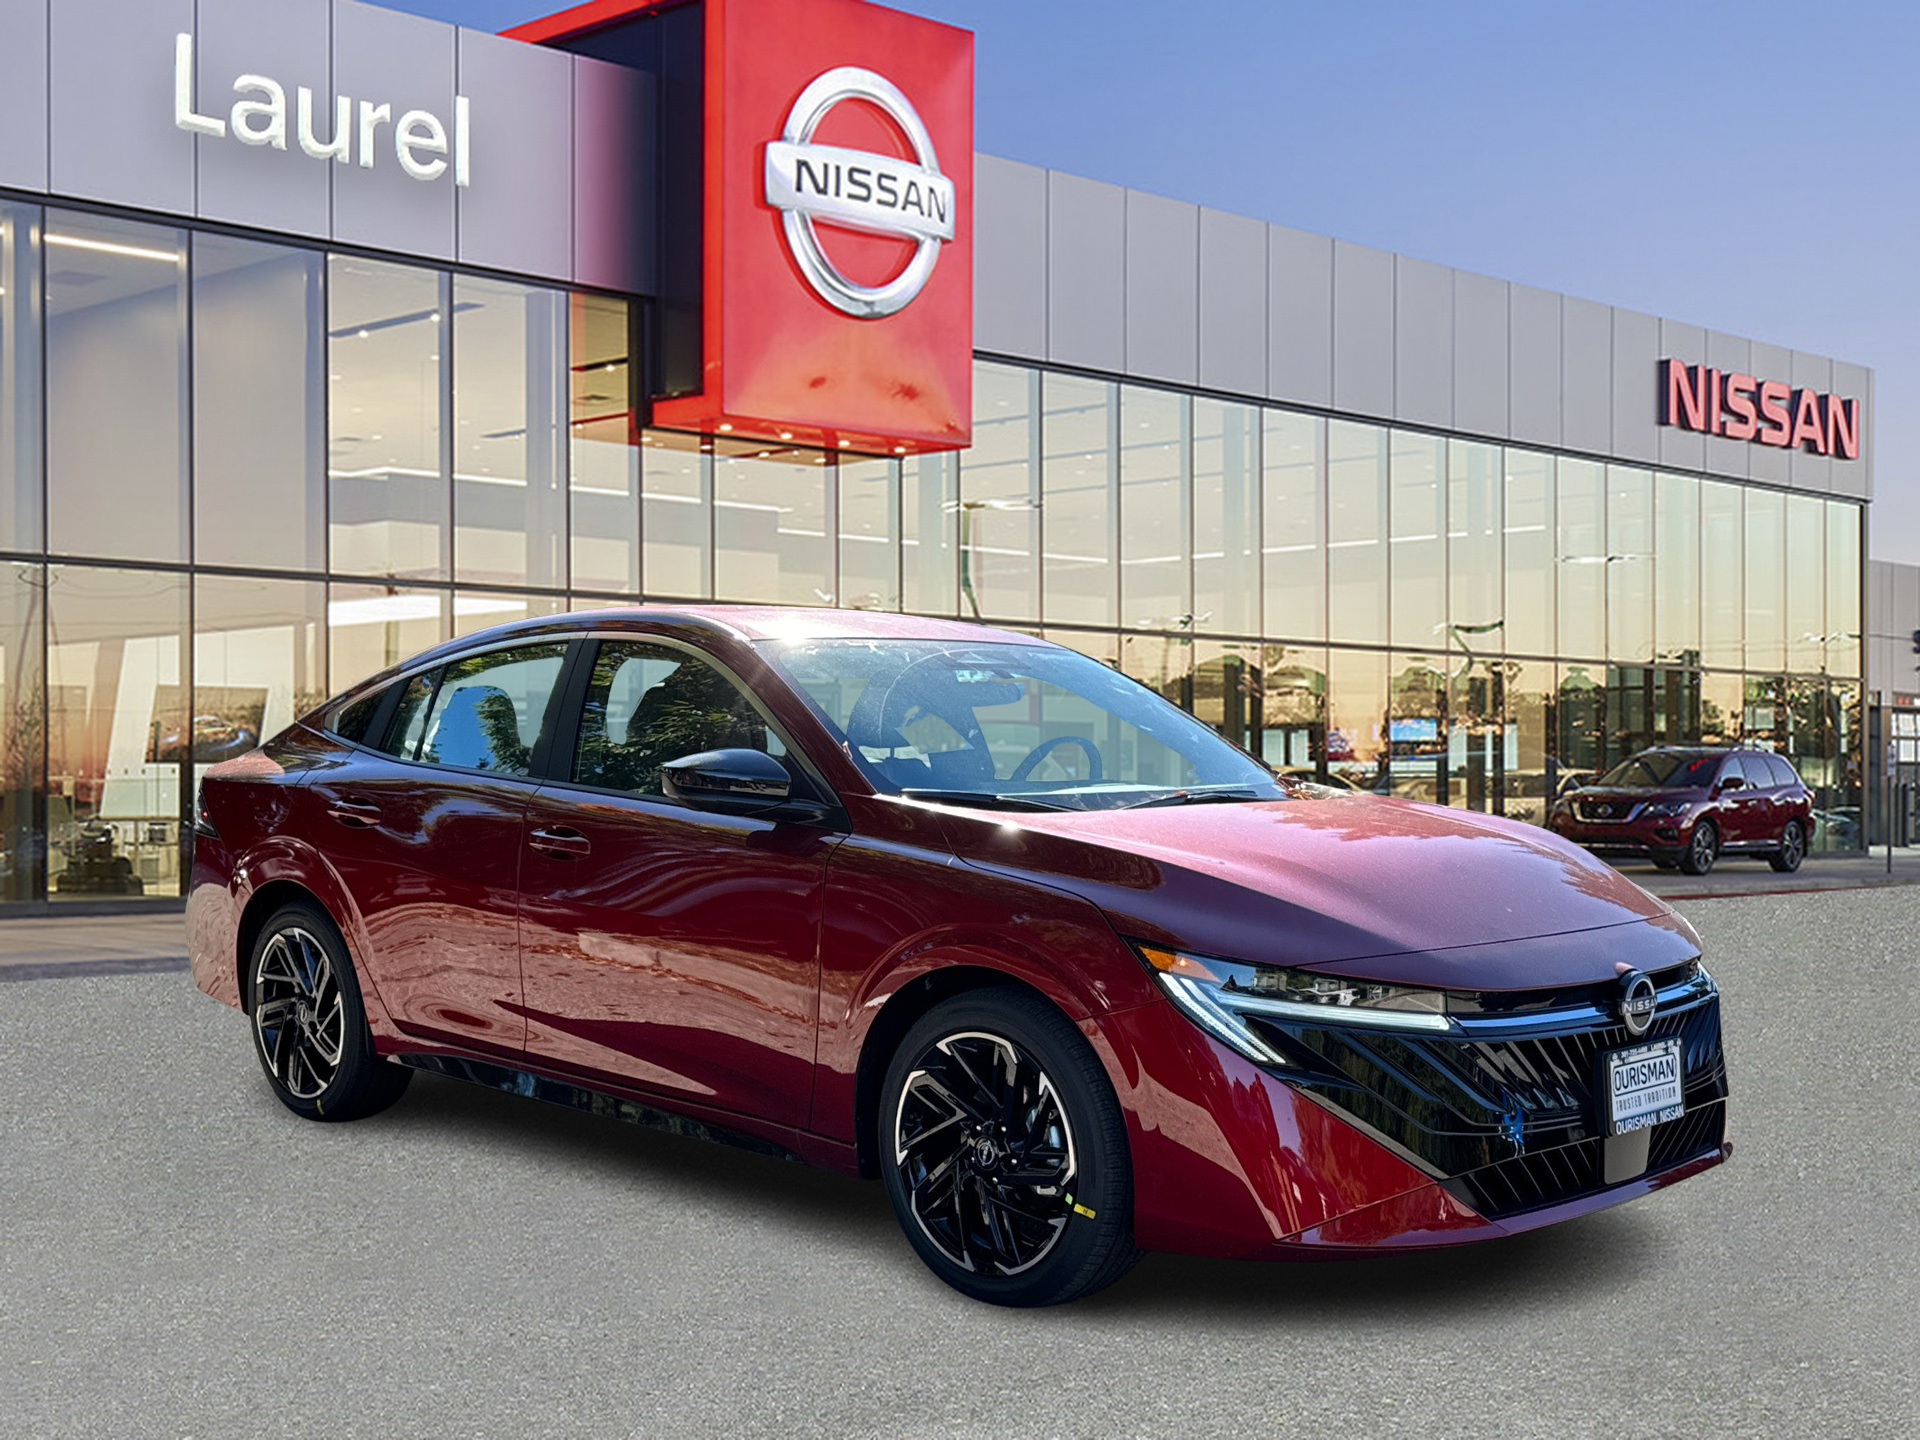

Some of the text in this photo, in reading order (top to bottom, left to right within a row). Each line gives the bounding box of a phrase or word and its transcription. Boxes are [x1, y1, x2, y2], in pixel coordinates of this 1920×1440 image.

[175, 32, 470, 187] Laurel
[795, 158, 947, 224] NISSAN
[1658, 358, 1859, 460] NISSAN
[1614, 1058, 1675, 1091] OURISMAN
[1615, 1086, 1677, 1112] TRUSTED TRADITION
[1615, 1103, 1685, 1135] OURISMAN NISSAN
